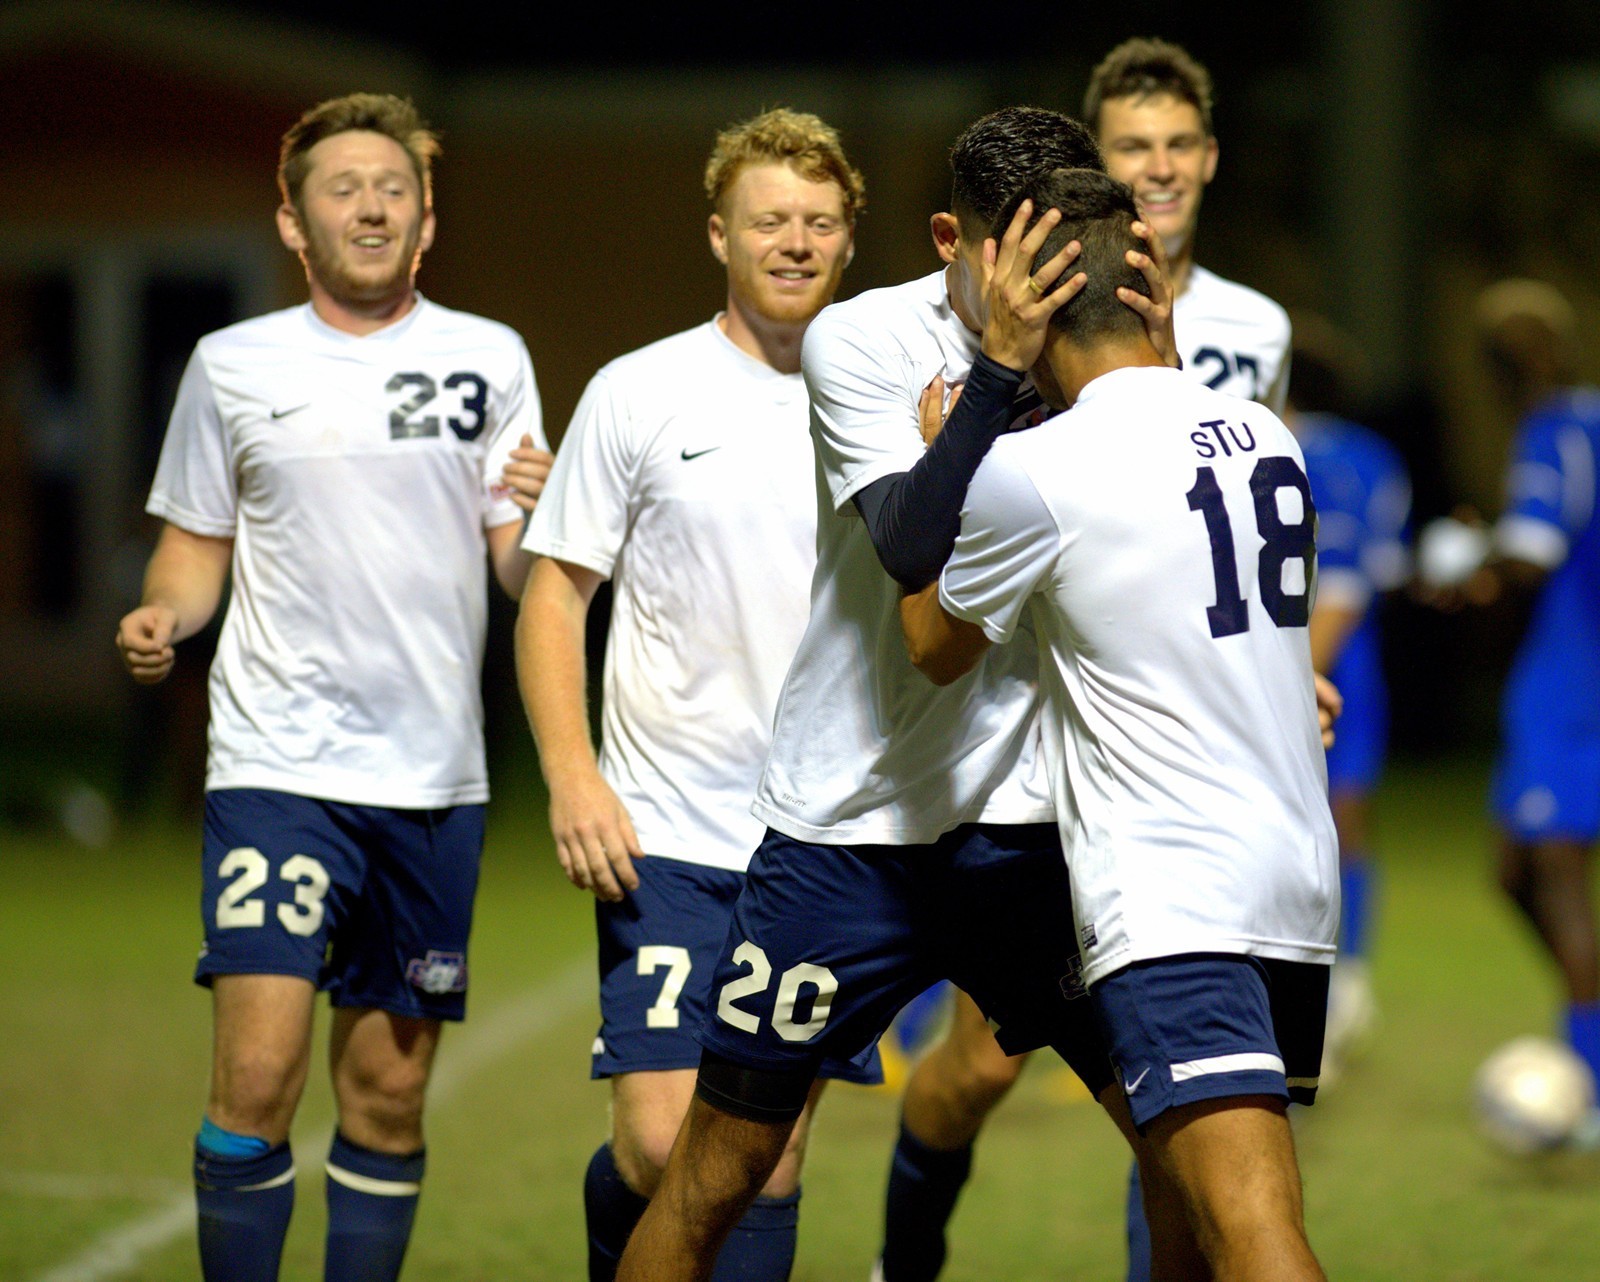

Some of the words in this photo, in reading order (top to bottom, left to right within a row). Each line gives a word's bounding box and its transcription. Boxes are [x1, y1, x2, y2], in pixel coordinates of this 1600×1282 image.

[385, 371, 489, 442] 23
[1190, 419, 1256, 459] STU
[1185, 456, 1318, 638] 18
[216, 847, 330, 937] 23
[637, 945, 692, 1028] 7
[717, 940, 839, 1042] 20
